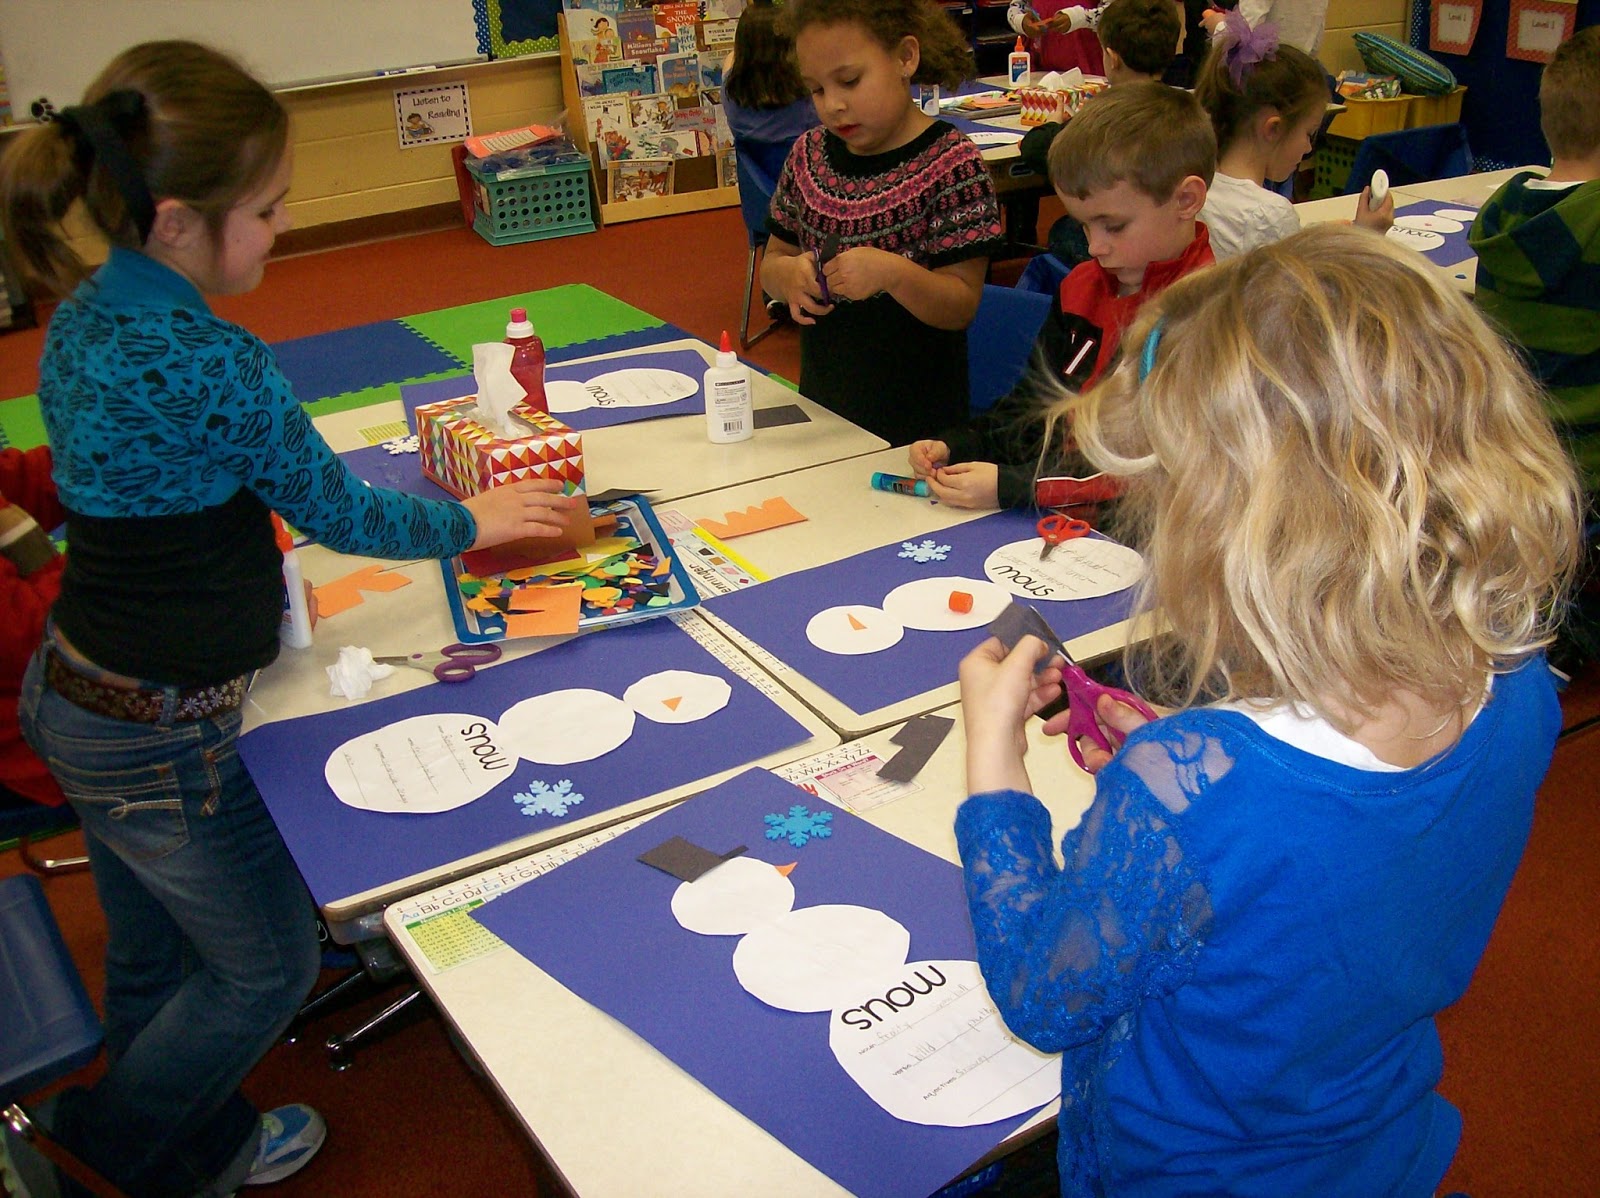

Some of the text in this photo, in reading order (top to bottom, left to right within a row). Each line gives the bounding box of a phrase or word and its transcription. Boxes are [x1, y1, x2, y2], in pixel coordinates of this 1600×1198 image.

[666, 14, 697, 23] SNOWY
[627, 42, 652, 50] Millions
[631, 47, 666, 56] Snowflakes
[412, 94, 451, 107] Listen to
[427, 108, 461, 120] Reading
[1391, 226, 1436, 239] snow
[585, 385, 616, 406] snow
[991, 565, 1055, 597] snow
[460, 722, 510, 771] snow
[401, 911, 420, 922] Aa
[420, 903, 440, 914] Bb
[442, 897, 462, 906] Cc
[462, 888, 482, 899] Dd
[483, 880, 500, 892] Ee
[501, 874, 517, 885] Ff
[519, 868, 542, 879] Gg
[841, 965, 947, 1030] snow
